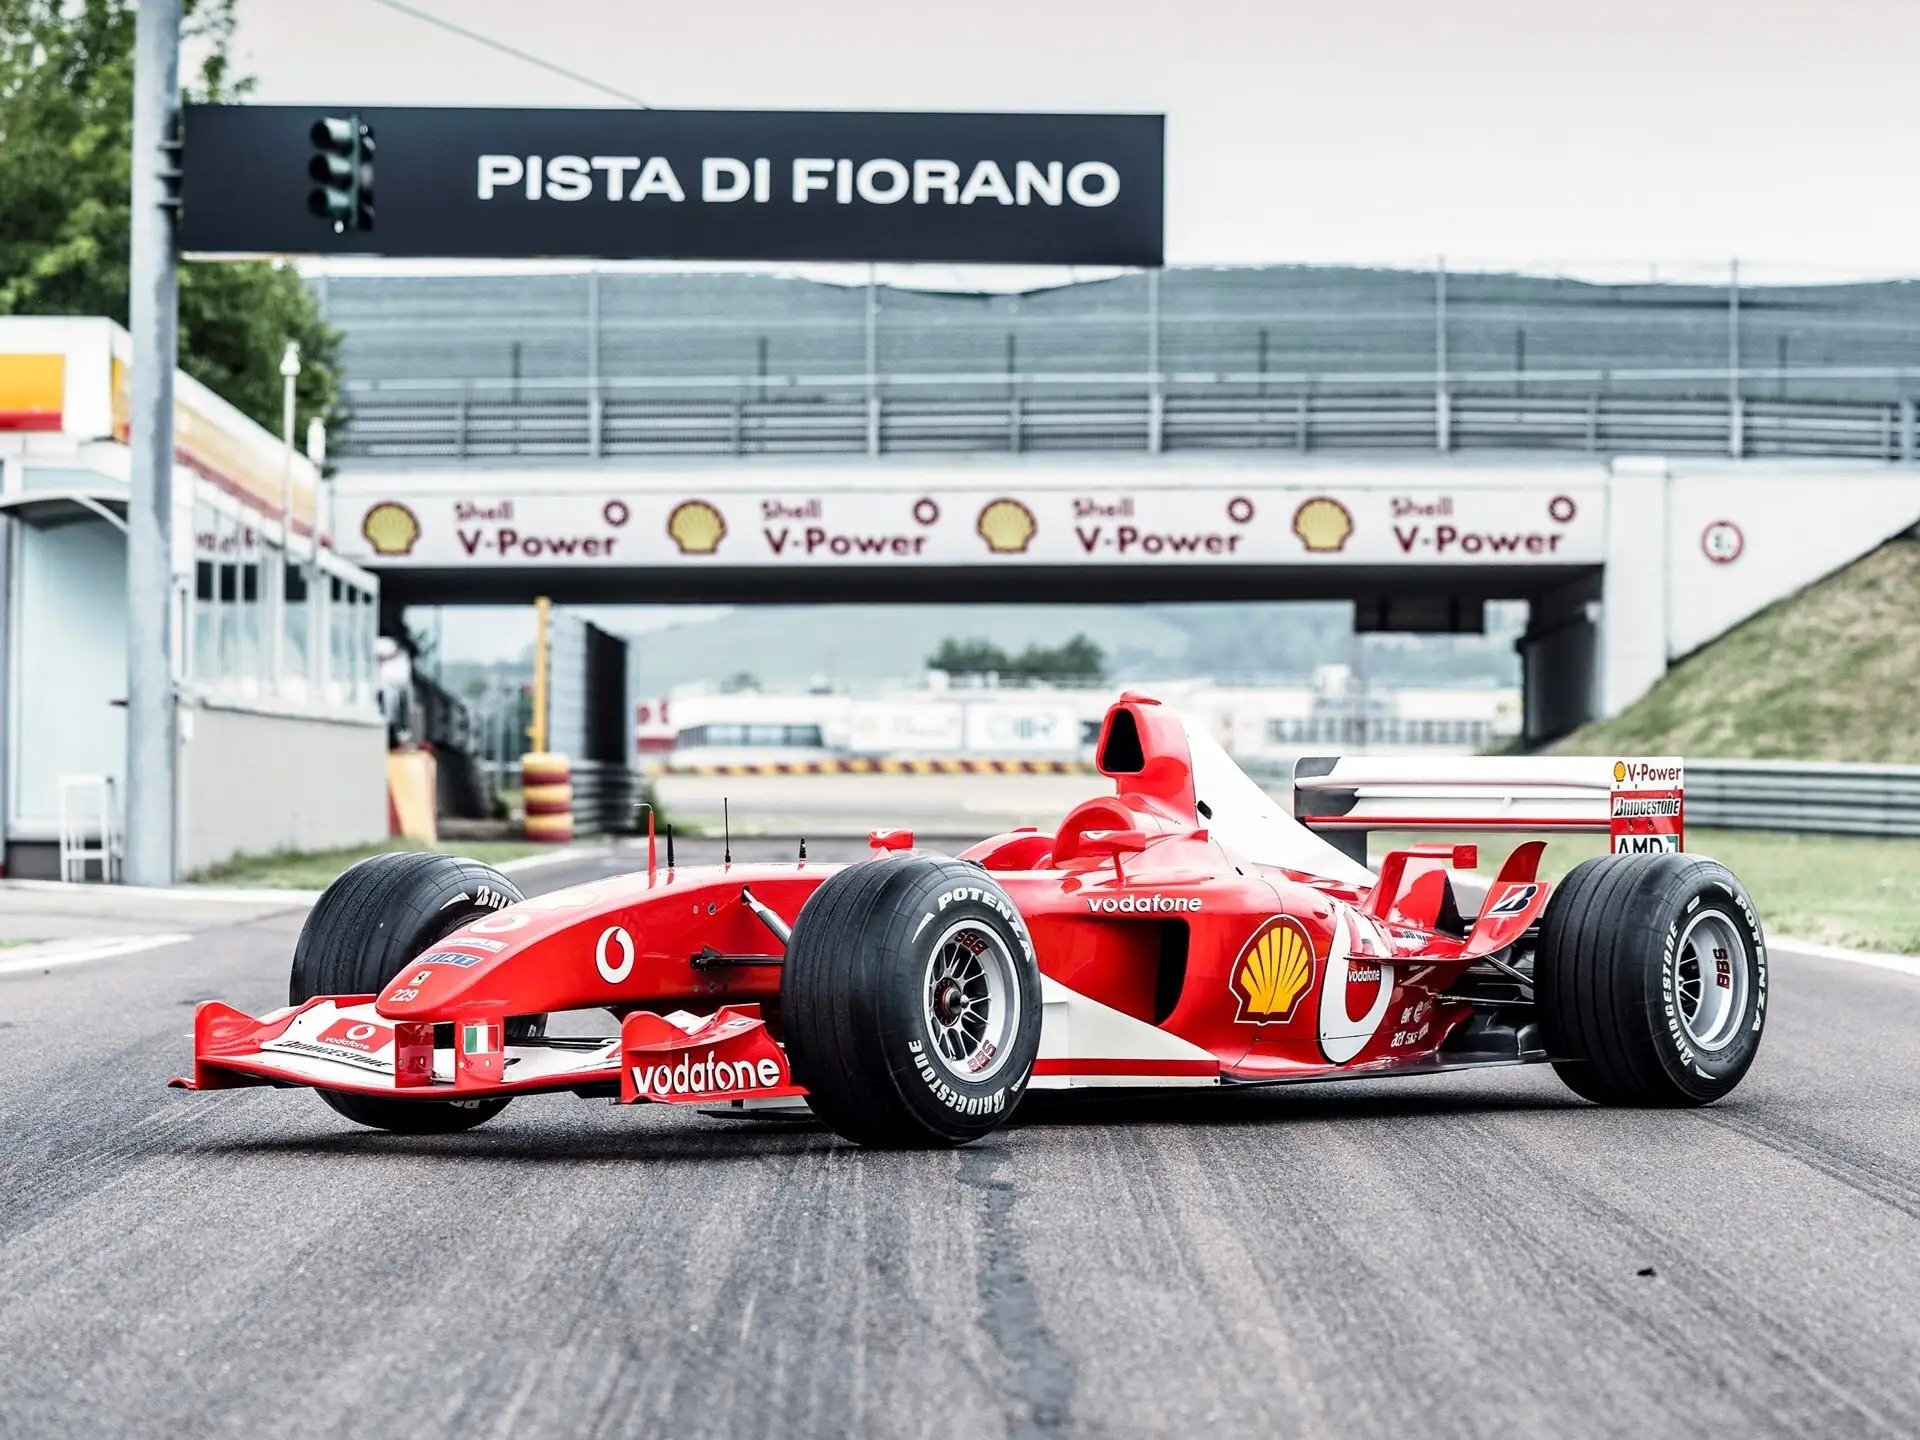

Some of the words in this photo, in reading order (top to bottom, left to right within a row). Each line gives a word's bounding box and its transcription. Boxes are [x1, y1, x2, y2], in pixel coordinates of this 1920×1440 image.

[477, 154, 686, 203] PISTA
[701, 156, 771, 203] DI
[792, 157, 1121, 207] FIORANO
[455, 500, 513, 521] Shell
[761, 500, 821, 519] Shell
[1073, 499, 1134, 517] Shell
[456, 529, 618, 556] V-Power
[763, 528, 926, 555] V-Power
[1075, 526, 1241, 554] V-Power
[1393, 525, 1563, 554] V-Power
[1627, 763, 1681, 781] V-Power
[1614, 799, 1680, 817] BRIDGESTONE
[1618, 837, 1663, 853] AMD
[1088, 893, 1202, 913] vodafone
[937, 887, 1032, 963] POTENZA
[1348, 967, 1381, 983] vodafone
[1712, 948, 1731, 989] BBS
[1735, 894, 1767, 1032] POTENZA
[388, 988, 420, 1002] 229
[1662, 920, 1695, 1067] BRIDGESTONE
[631, 1050, 780, 1095] vodafone
[908, 1039, 1006, 1116] BRIDGESTONE
